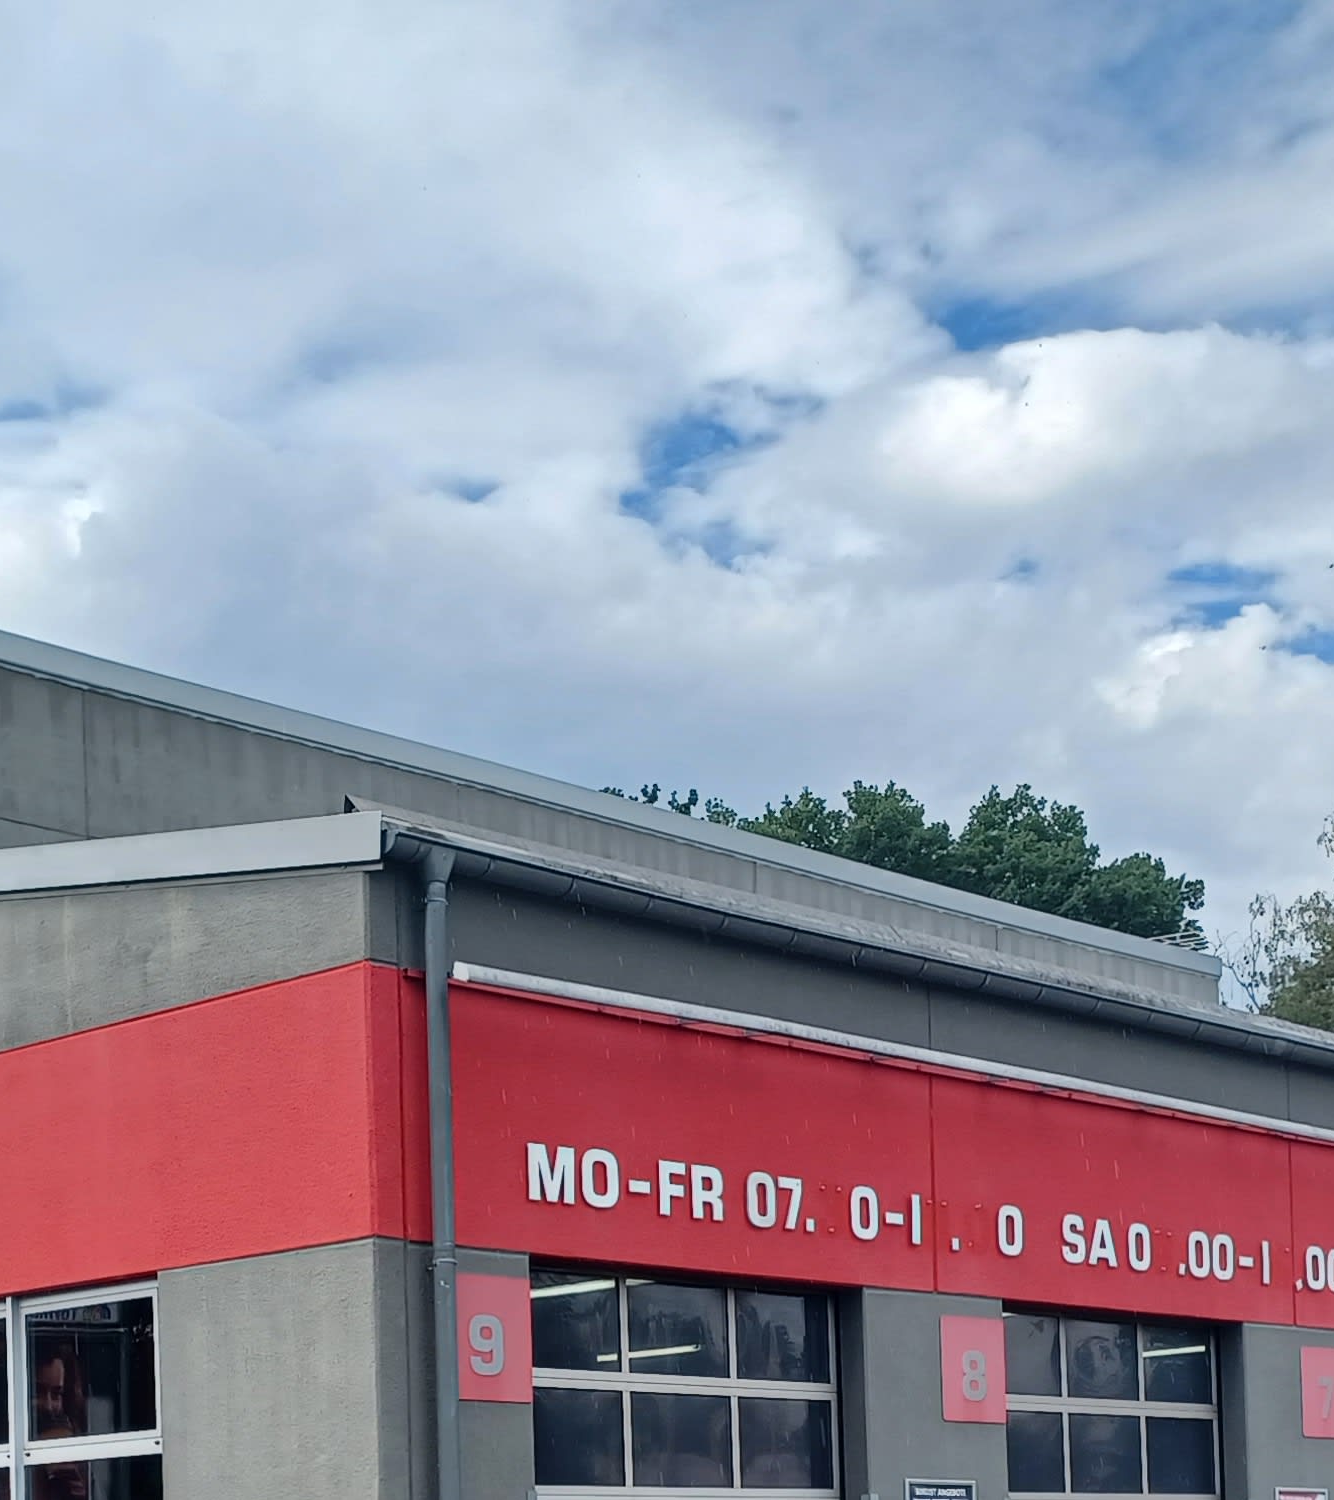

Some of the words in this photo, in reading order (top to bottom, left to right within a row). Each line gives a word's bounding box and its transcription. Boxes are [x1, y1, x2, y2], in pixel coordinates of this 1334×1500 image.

[526, 1142, 725, 1223] MO-FR
[466, 1313, 505, 1377] 9
[962, 1347, 986, 1401] 8
[1318, 1376, 1334, 1419] 7
